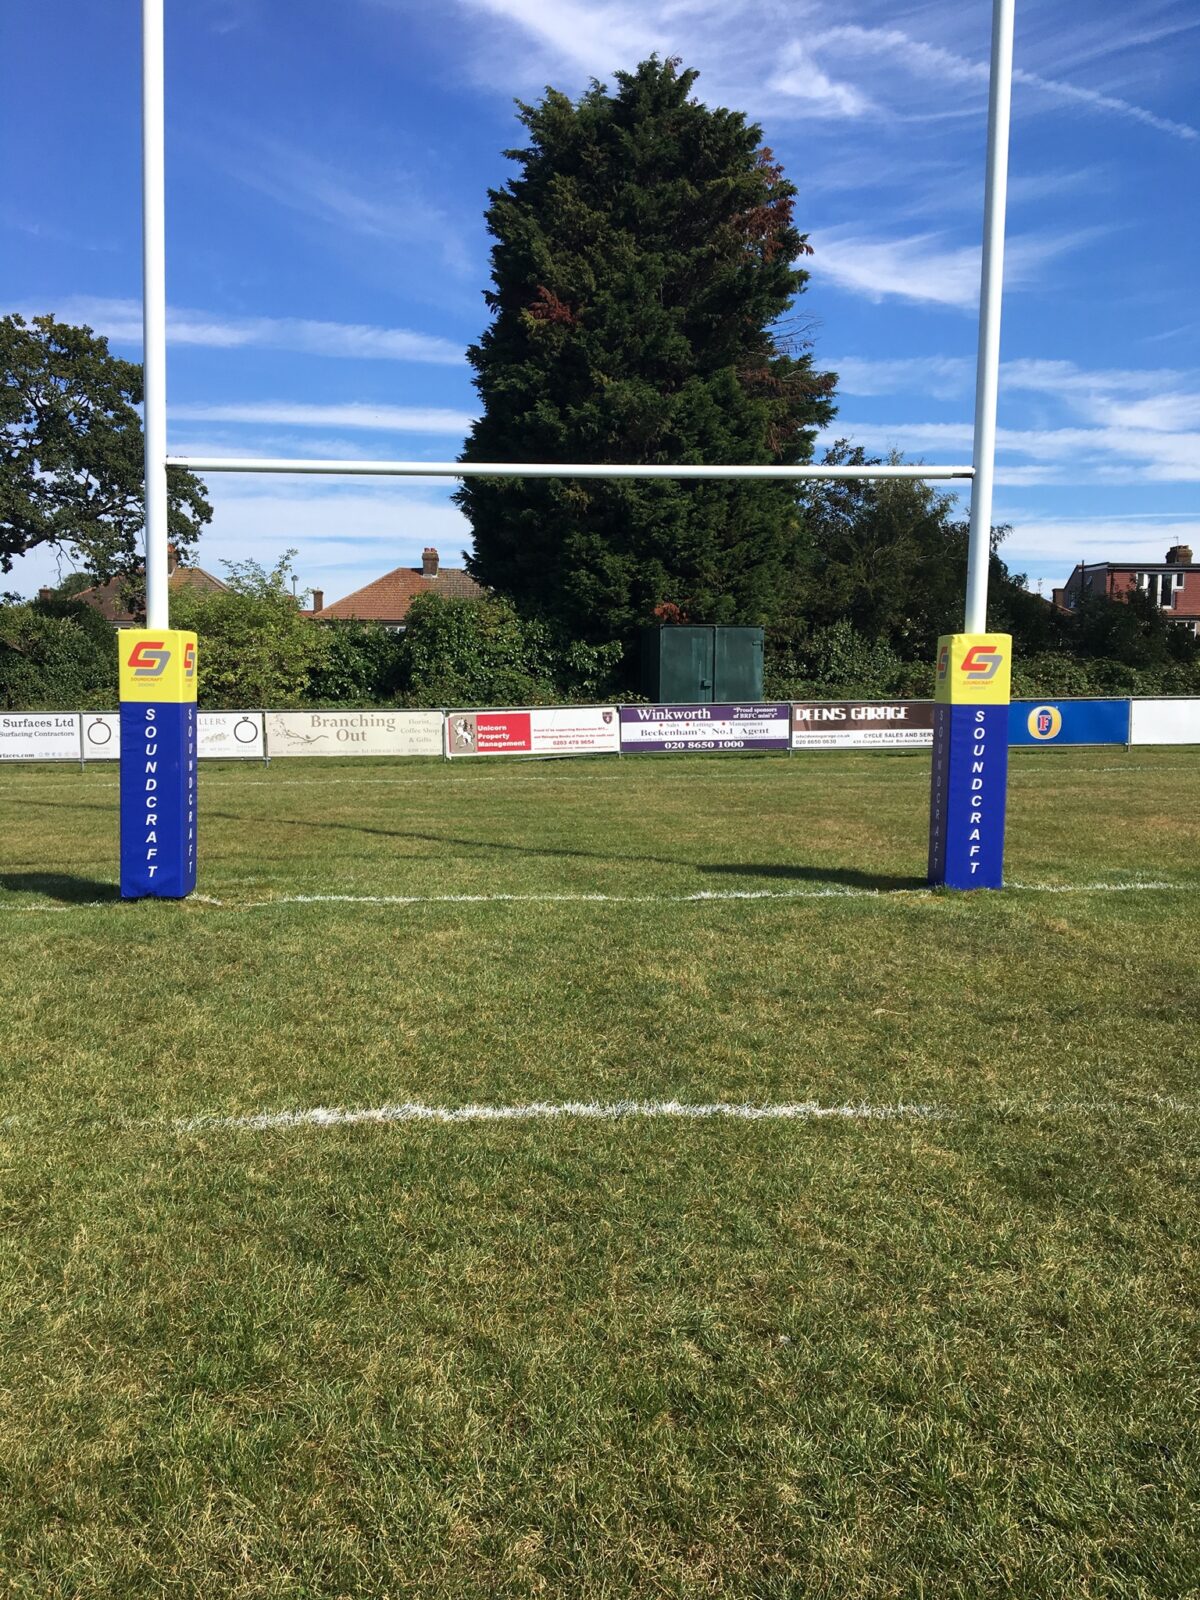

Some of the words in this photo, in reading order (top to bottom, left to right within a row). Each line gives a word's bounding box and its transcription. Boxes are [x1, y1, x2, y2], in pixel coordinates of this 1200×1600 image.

[637, 708, 712, 721] Winkworth
[795, 707, 847, 721] DEENS
[850, 706, 910, 720] GARAGE
[3, 718, 52, 728] Surfaces
[55, 718, 74, 728] Ltd
[311, 714, 396, 732] Branching
[336, 728, 368, 742] Out
[478, 732, 510, 741] Property
[641, 728, 706, 737] Beckenham's
[740, 728, 769, 736] Agent
[478, 740, 526, 748] Management
[664, 741, 685, 749] 020
[687, 741, 715, 749] 8650
[718, 740, 745, 748] 1000
[145, 708, 158, 878] SOUNDCRAFT
[969, 710, 986, 874] SOUNDCRAFT
